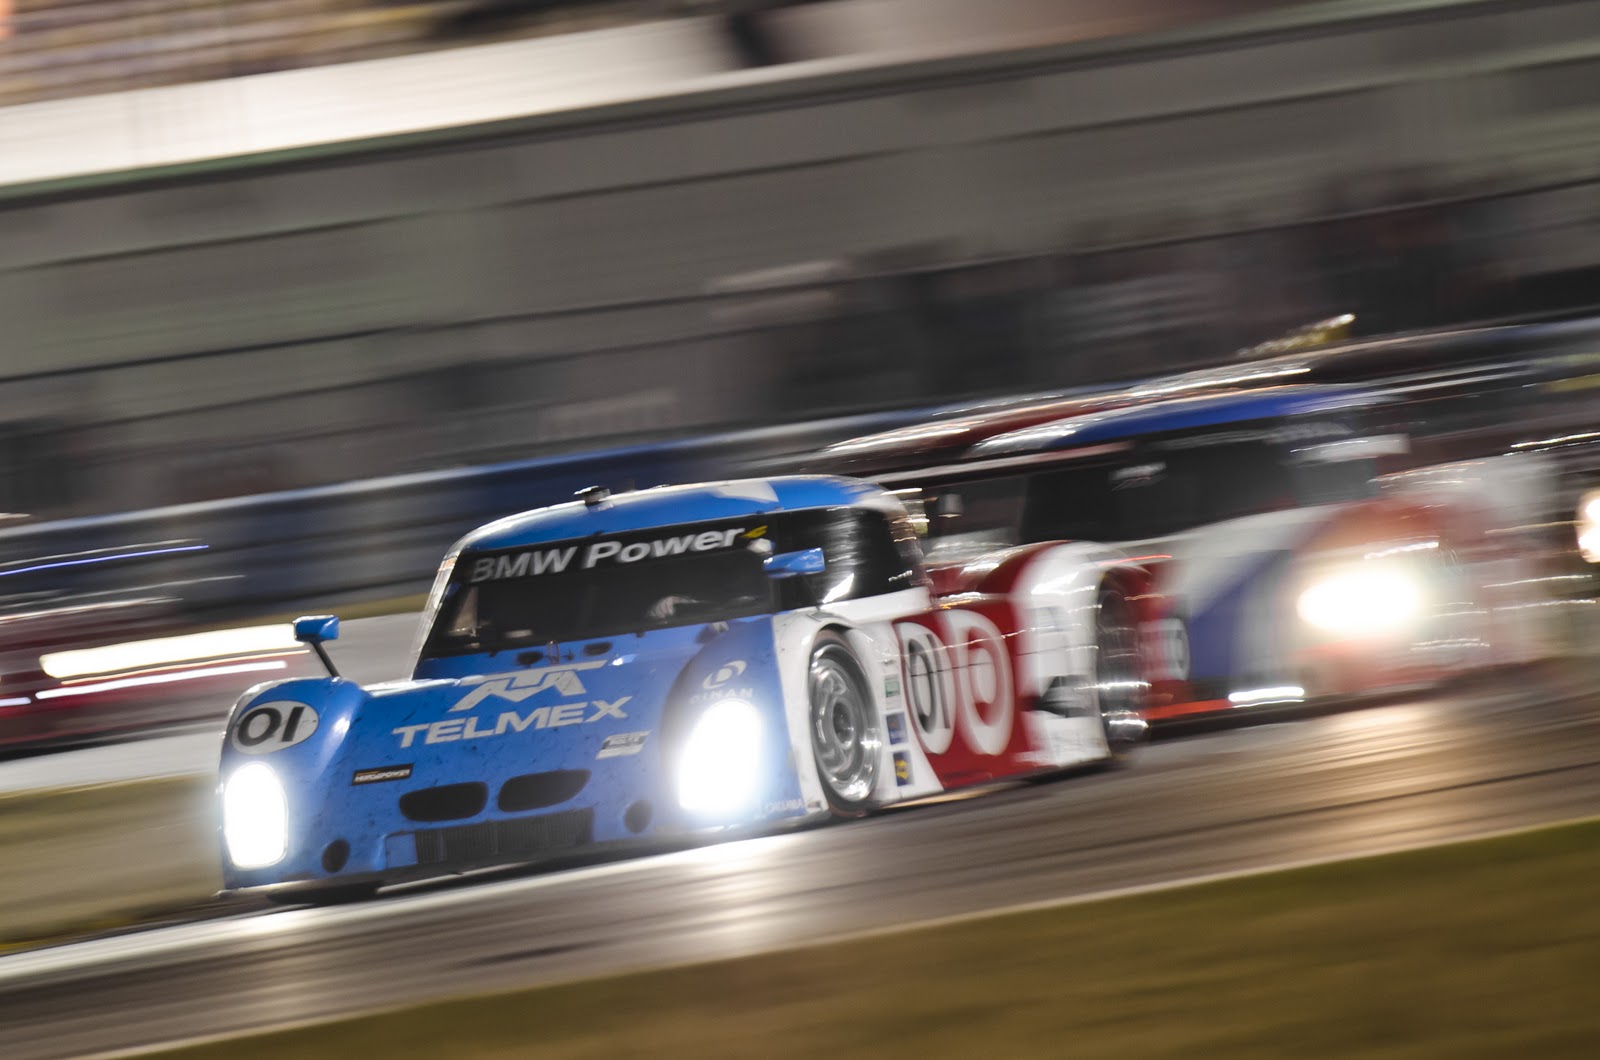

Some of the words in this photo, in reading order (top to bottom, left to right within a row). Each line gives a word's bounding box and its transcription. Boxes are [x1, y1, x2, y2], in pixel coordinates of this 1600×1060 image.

[471, 546, 578, 582] BMW
[582, 527, 745, 569] Power
[907, 633, 951, 734] 01
[238, 706, 305, 747] 01
[392, 696, 632, 748] TELMEX
